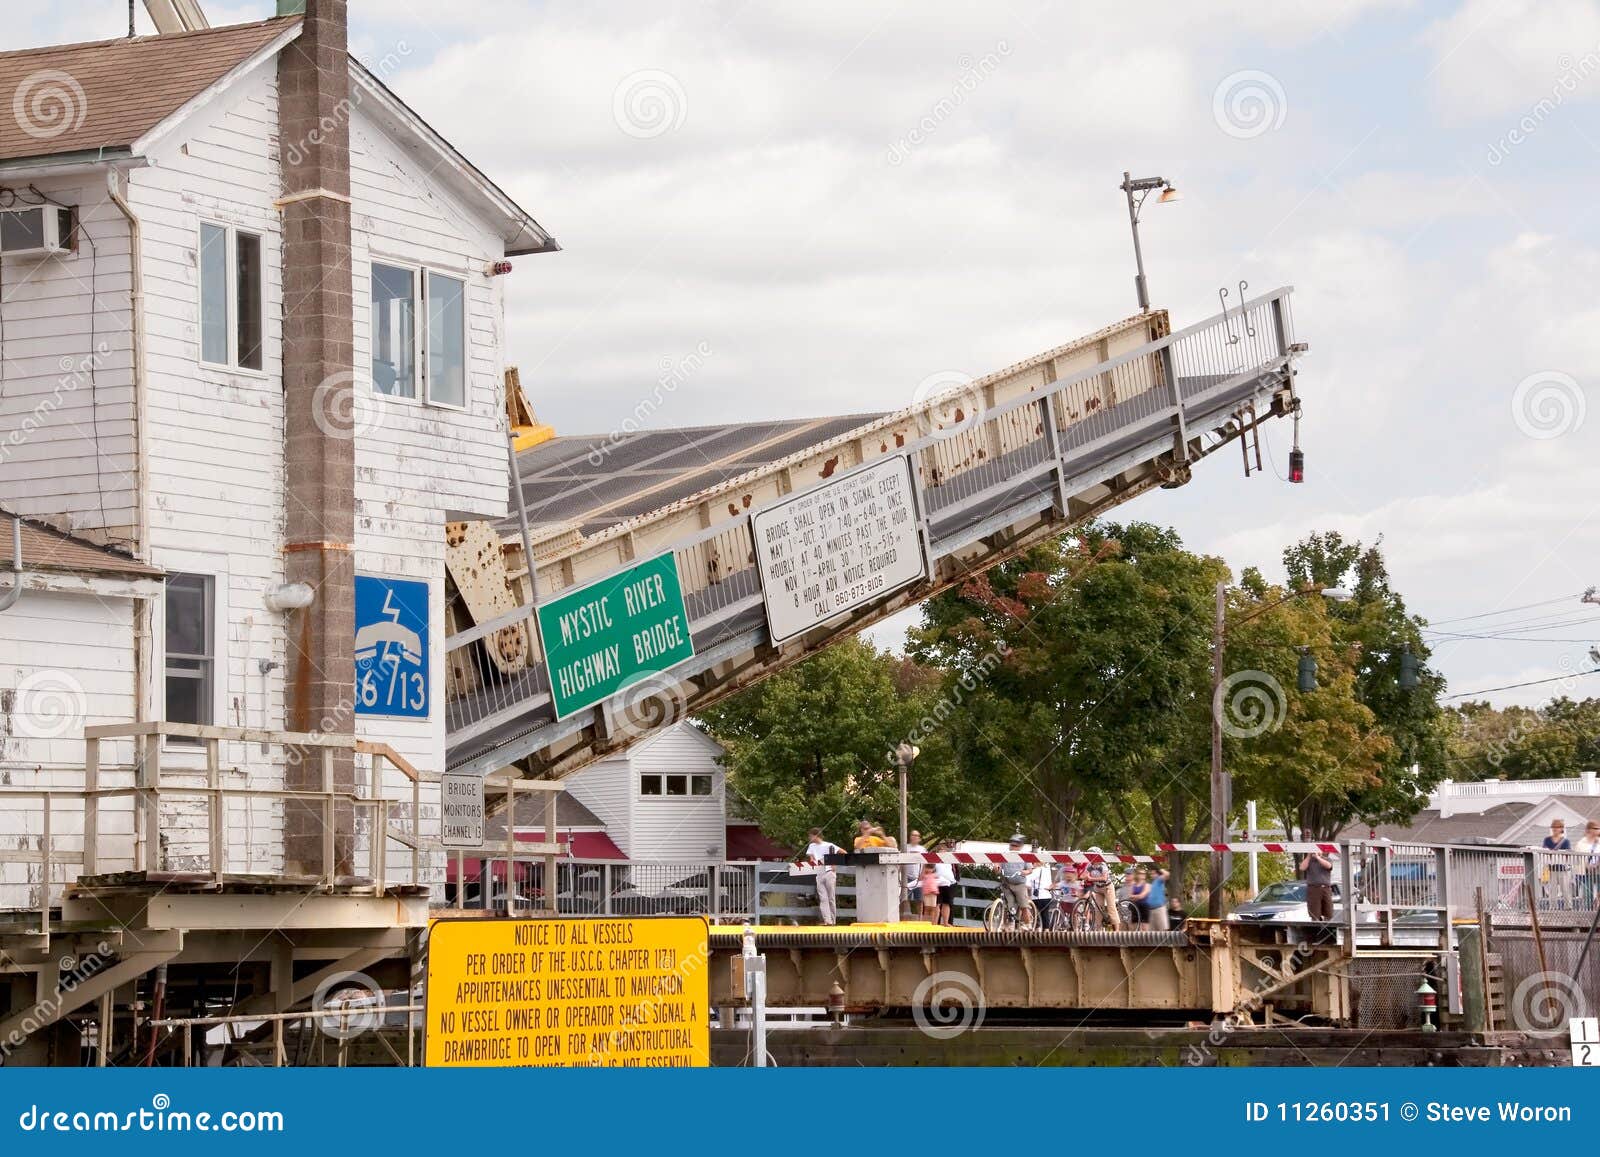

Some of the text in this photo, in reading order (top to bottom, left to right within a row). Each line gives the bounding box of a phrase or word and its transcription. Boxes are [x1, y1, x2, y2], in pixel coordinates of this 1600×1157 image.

[766, 473, 900, 543] BRIDGE SHALL OPEN ON SIGNAL EXCEPT
[770, 542, 783, 561] MAY
[887, 490, 902, 510] ONCE
[769, 507, 908, 580] HOURLY AT 40 MINUTES PAST THE HOUR
[793, 593, 799, 608] 8
[803, 583, 820, 604] HOUR
[843, 563, 865, 585] NOTICE
[869, 548, 897, 573] REQUIRED
[559, 573, 667, 647] MYSTIC RIVER
[814, 574, 883, 618] CALL 860-873-8106
[558, 615, 684, 700] HIGHWAY BRIDGE
[400, 672, 425, 711] 13
[448, 782, 477, 796] BRIDGE
[444, 803, 481, 817] MONITORS
[444, 825, 482, 838] CHANNEL 13
[515, 923, 633, 946] NOTICE TO ALL VESSELS
[466, 953, 486, 976] PER
[492, 952, 526, 975] ORDER
[531, 951, 544, 973] OF
[549, 951, 566, 972] THE
[608, 949, 650, 970] CHAPTER
[456, 980, 541, 1004] APPURTENANCES
[547, 977, 611, 1000] UNESSENTIAL
[615, 976, 626, 997] TO
[440, 1002, 697, 1034] NO VESSEL OWNER OR OPERATOR SHALL SIGNAL A
[444, 1037, 511, 1063] DRAWBRIDGE
[517, 1036, 529, 1058] TO
[535, 1035, 561, 1057] OPEN
[568, 1033, 586, 1055] FOR
[591, 1032, 611, 1054] ANY
[615, 1028, 694, 1052] NONSTRUCTURAL
[1581, 1045, 1592, 1065] 2
